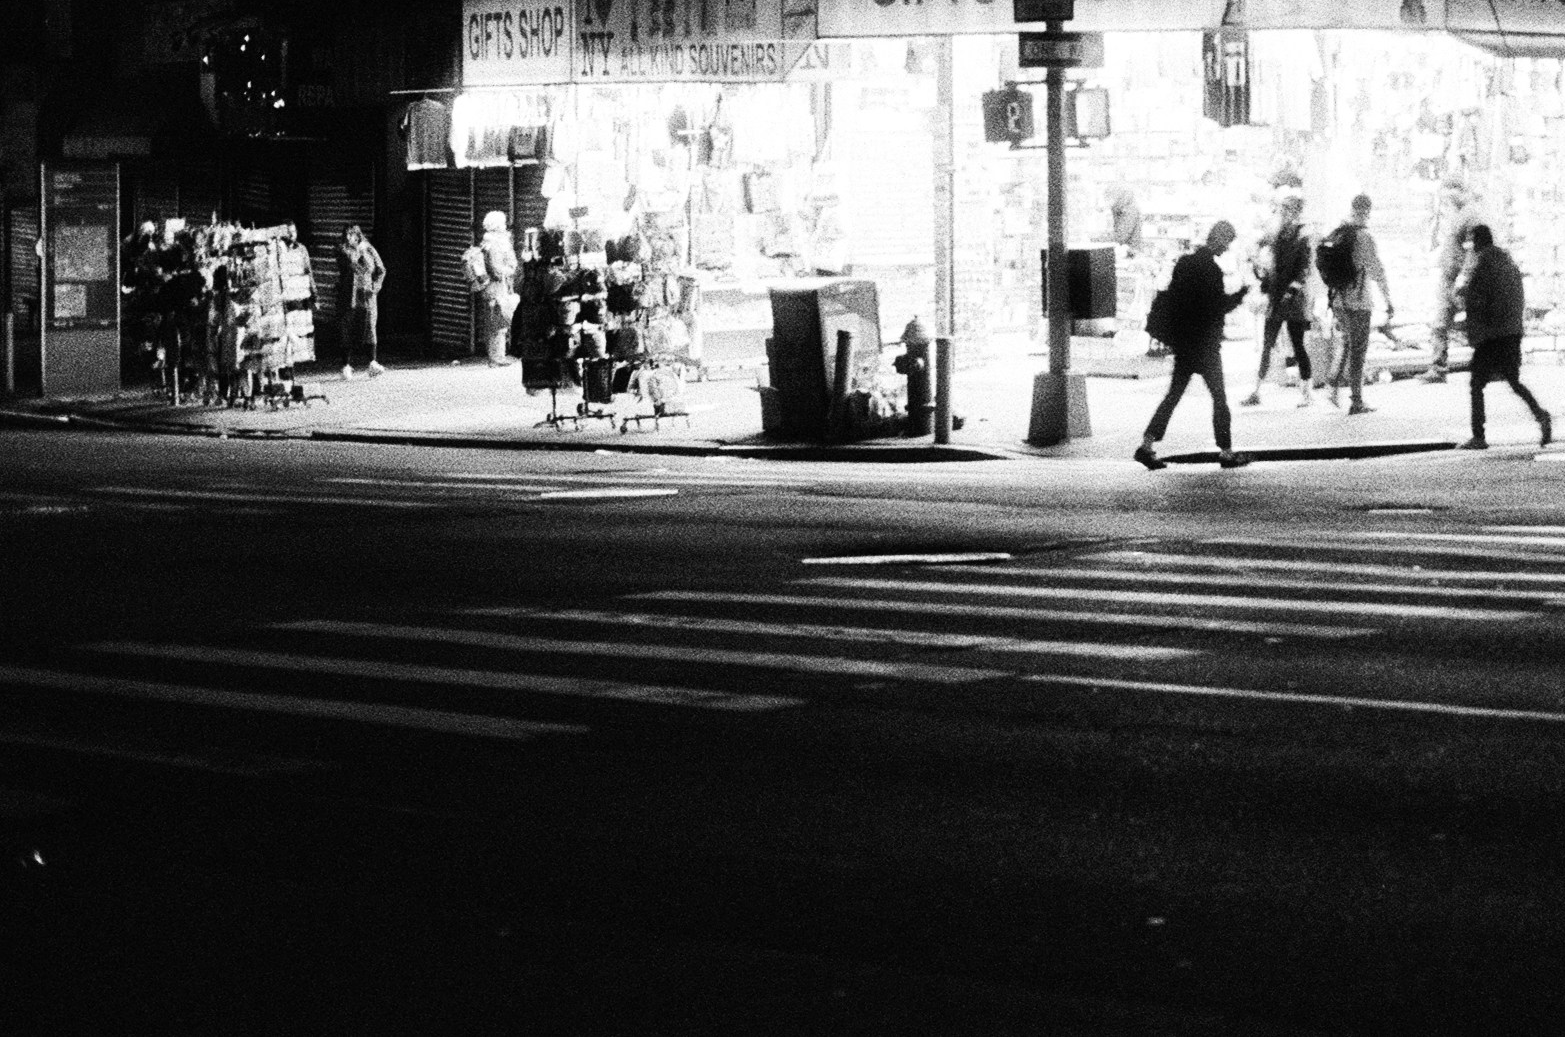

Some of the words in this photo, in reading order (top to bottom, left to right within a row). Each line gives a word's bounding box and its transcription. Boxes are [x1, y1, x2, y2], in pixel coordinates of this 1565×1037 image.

[468, 12, 514, 61] GIFTS
[518, 6, 565, 59] SHOP
[649, 43, 684, 76] KIND
[688, 42, 778, 76] SOUVENIRS
